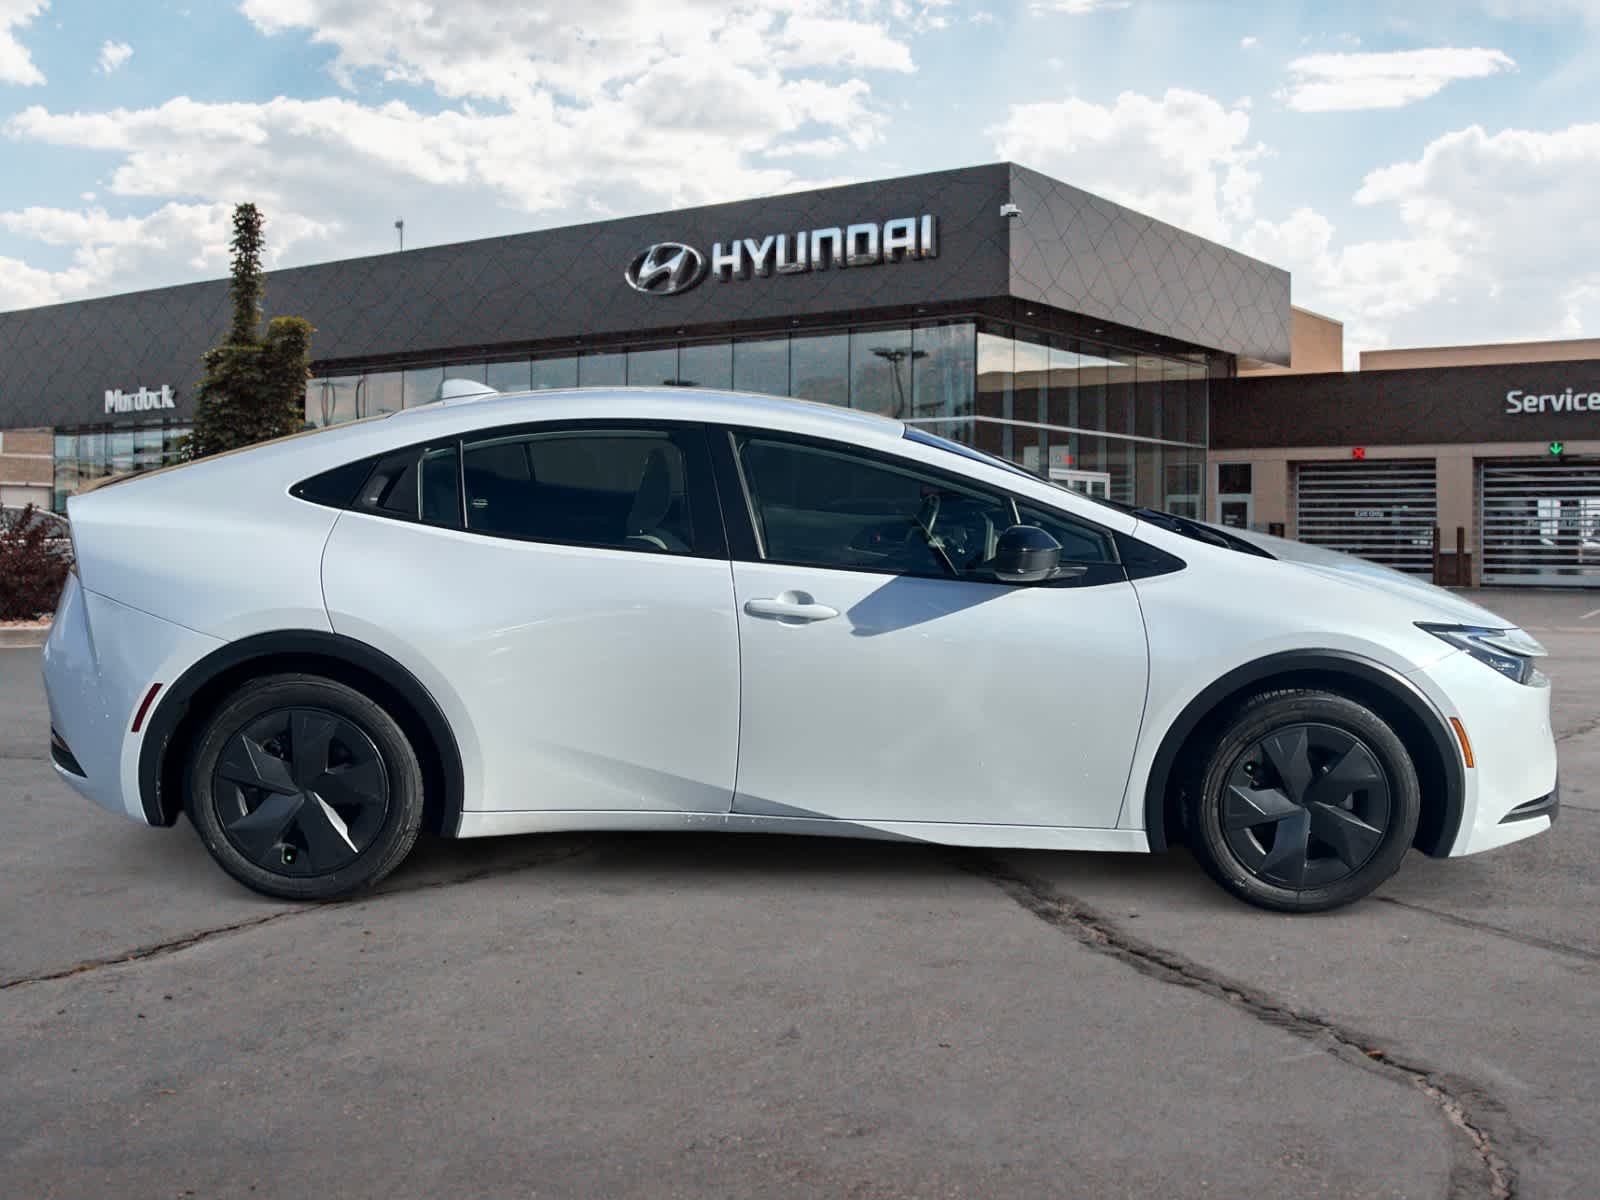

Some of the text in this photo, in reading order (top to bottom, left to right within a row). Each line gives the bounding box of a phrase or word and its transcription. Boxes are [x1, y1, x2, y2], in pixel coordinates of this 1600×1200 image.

[712, 214, 935, 277] HYUNDAI
[104, 384, 176, 414] Murdock
[1505, 387, 1600, 413] Service
